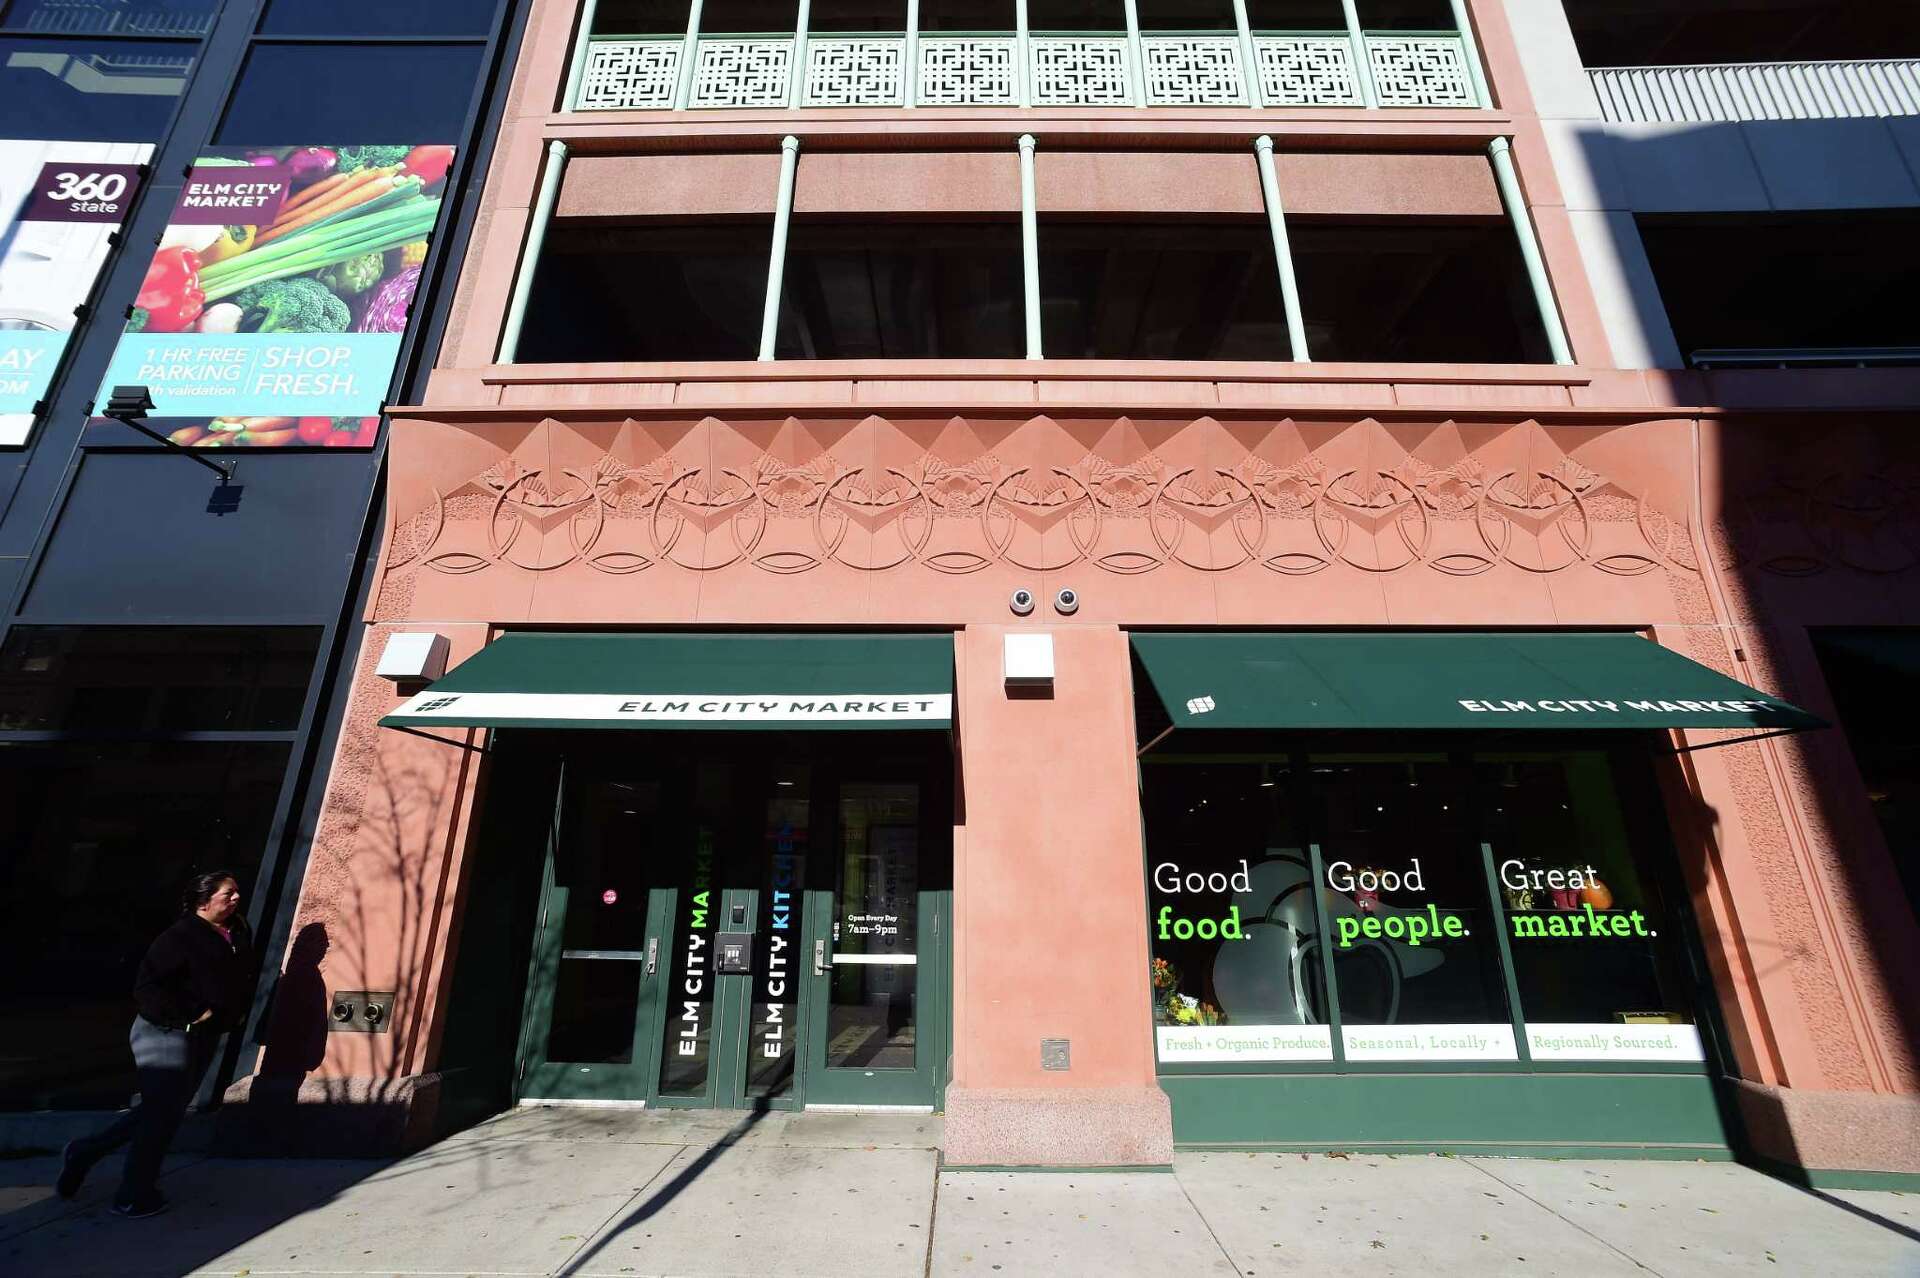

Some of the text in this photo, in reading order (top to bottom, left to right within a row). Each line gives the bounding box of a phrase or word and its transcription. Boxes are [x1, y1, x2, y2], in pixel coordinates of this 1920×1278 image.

[48, 172, 127, 202] 360
[188, 183, 282, 195] ELM CITY
[70, 200, 118, 214] state
[183, 196, 269, 208] MARKET
[145, 347, 250, 362] 1 HR FREE
[262, 346, 351, 368] SHOP.
[136, 364, 241, 381] PARKING
[168, 383, 237, 396] validation
[255, 373, 359, 396] FRESH.
[617, 701, 935, 713] ELM CITY MARKET
[1458, 699, 1777, 713] ELM CITY MARKET
[1154, 859, 1253, 893] Good
[1327, 858, 1426, 892] Good
[1500, 859, 1601, 890] Great
[848, 914, 898, 922] Open Every Day
[1157, 906, 1252, 940] food.
[1336, 904, 1470, 947] people.
[1511, 903, 1657, 938] market.
[685, 934, 706, 995] CITY
[768, 935, 788, 997] CITY
[679, 1001, 700, 1056] ELM
[764, 1003, 784, 1058] ELM
[1165, 1038, 1202, 1051] Fresh
[1216, 1037, 1270, 1053] Organic
[1273, 1037, 1331, 1051] Produce.
[1350, 1037, 1425, 1052] Seasonal,
[1430, 1035, 1487, 1051] Locally
[1533, 1035, 1679, 1051] Regionally Sourced.
